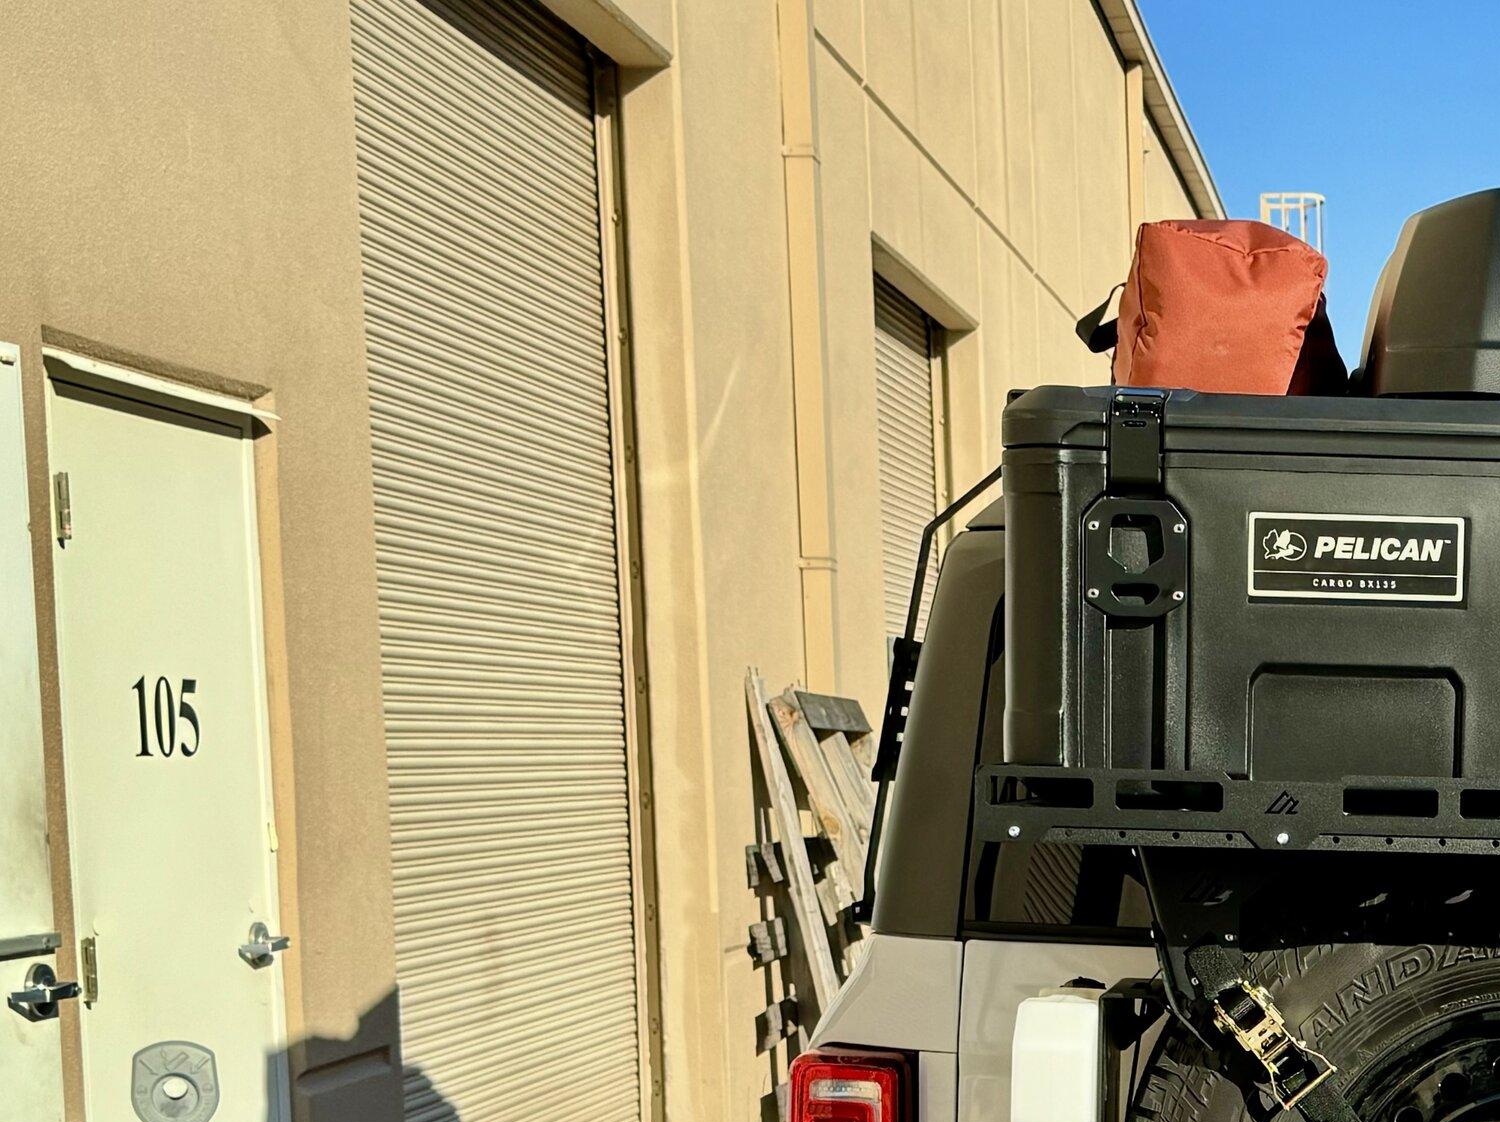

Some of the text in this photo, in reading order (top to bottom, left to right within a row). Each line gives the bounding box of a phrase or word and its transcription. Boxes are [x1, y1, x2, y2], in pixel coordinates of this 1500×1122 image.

[1314, 536, 1444, 562] PELICAN
[1313, 578, 1354, 589] CARGO
[131, 674, 200, 758] 105
